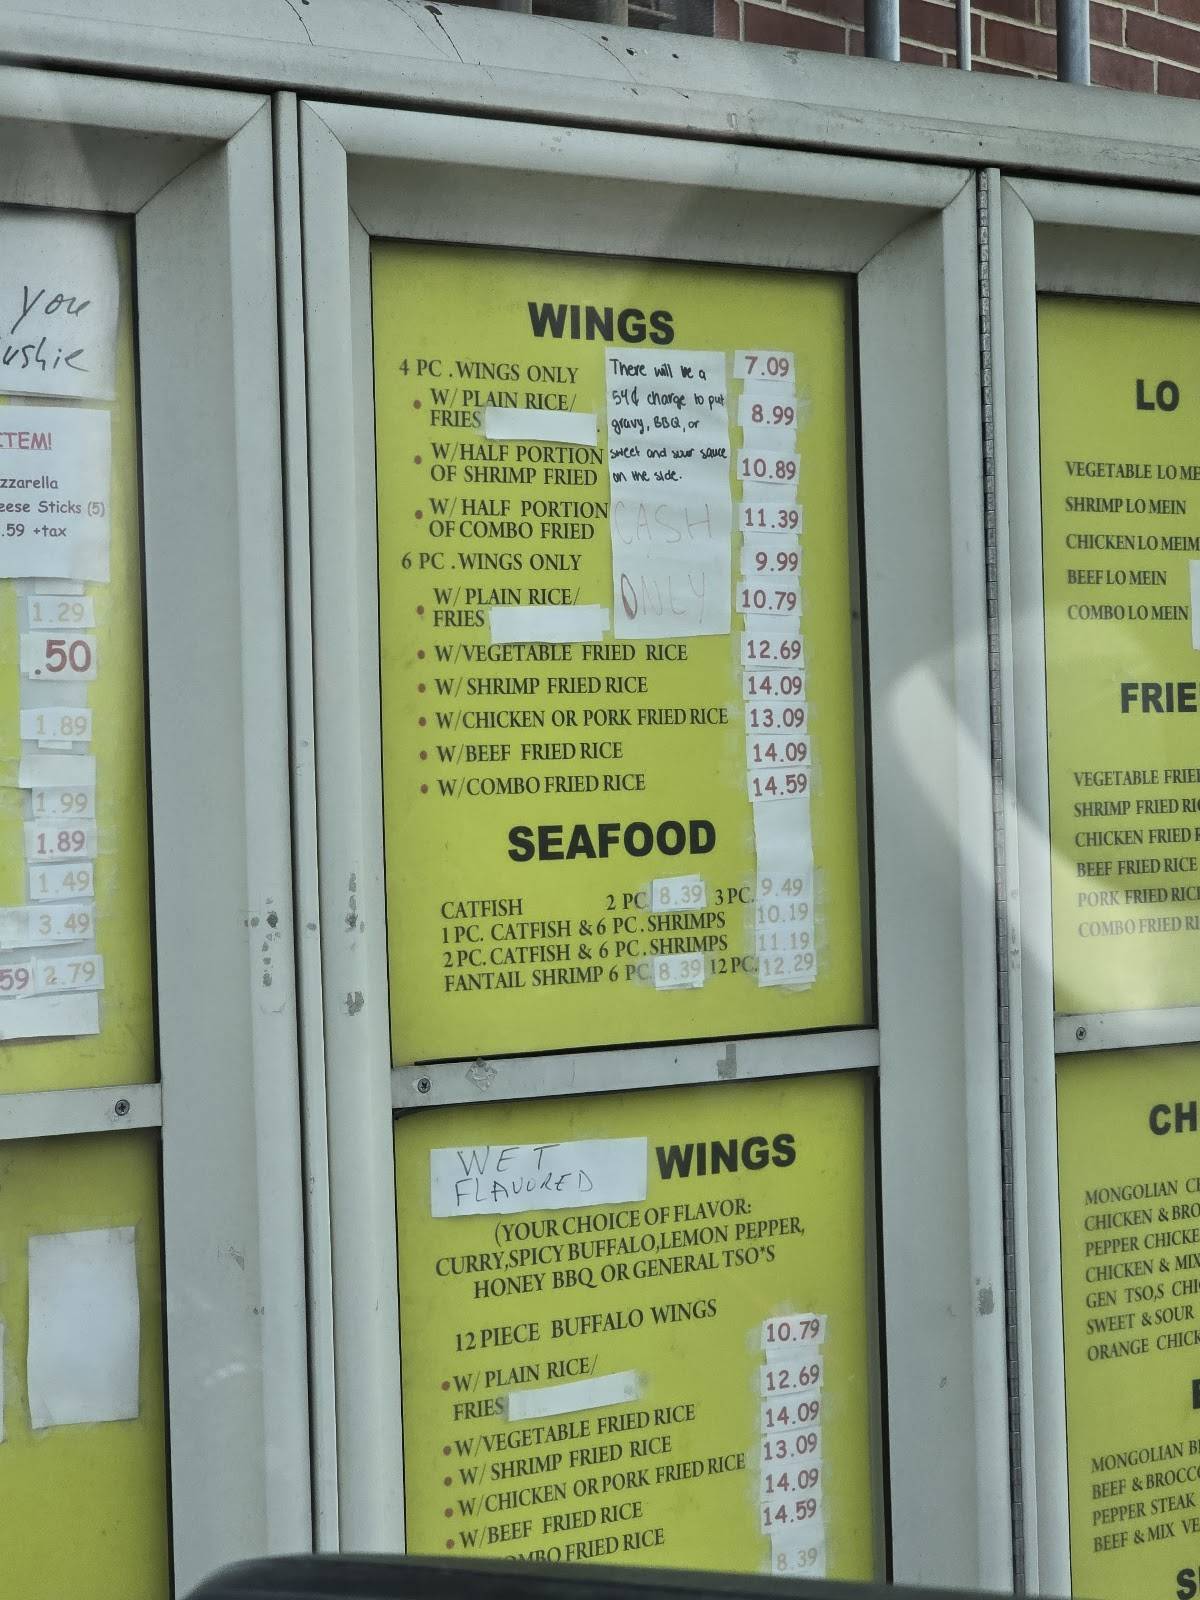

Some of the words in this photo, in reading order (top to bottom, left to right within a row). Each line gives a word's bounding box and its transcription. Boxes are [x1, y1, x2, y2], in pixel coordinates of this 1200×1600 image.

[528, 301, 674, 345] WINGS
[527, 365, 578, 383] ONLY
[609, 359, 646, 377] There
[653, 365, 673, 379] will
[698, 369, 706, 380] a
[745, 356, 789, 376] 7.09
[523, 393, 576, 412] RICE/
[647, 391, 687, 410] charge
[694, 392, 704, 404] to
[708, 395, 725, 408] put
[1136, 378, 1179, 411] LO
[430, 410, 481, 428] FRIES
[751, 404, 794, 425] 8.99
[612, 419, 649, 432] gravy,
[689, 419, 699, 428] or
[516, 446, 603, 464] PORTION
[610, 447, 640, 459] sweet
[647, 448, 666, 458] and
[700, 447, 727, 459] sauce
[431, 465, 458, 483] OF
[464, 466, 536, 485] SHRIMP
[544, 468, 598, 486] FRIED
[613, 471, 627, 482] on
[632, 470, 650, 481] the
[655, 469, 682, 481] side.
[742, 459, 796, 479] 10.89
[1065, 461, 1152, 480] VEGETABLE
[1157, 465, 1177, 479] LO
[38, 500, 81, 514] Sticks
[87, 501, 105, 517] (5)
[521, 501, 608, 518] PORTION
[1065, 496, 1123, 513] SHRIMP
[1127, 499, 1146, 514] LO
[1149, 499, 1186, 515] MEIN
[613, 501, 712, 544] CASH
[744, 508, 798, 530] 11.39
[33, 525, 66, 537] +tax
[430, 520, 456, 538] OF
[460, 520, 532, 539] COMBO
[540, 522, 594, 540] FRIED
[1066, 533, 1135, 550] CHICKEN
[1138, 535, 1158, 550] LO
[530, 554, 581, 571] ONLY
[755, 551, 798, 571] 9.99
[1067, 569, 1103, 585] BEEF
[1107, 570, 1126, 585] LO
[1129, 570, 1166, 585] MEIN
[528, 587, 580, 606] RICE/
[620, 573, 706, 624] ONLY
[742, 589, 796, 609] 10.79
[434, 609, 484, 627] FRIES
[1067, 604, 1125, 621] COMBO
[1128, 605, 1148, 620] LO
[1151, 605, 1189, 620] MEIN
[35, 639, 90, 675] .50
[582, 644, 635, 662] FRIED
[646, 643, 687, 661] RICE
[748, 640, 801, 659] 12.69
[547, 677, 600, 694] FRIED
[606, 676, 648, 693] RICE
[748, 676, 801, 695] 14.09
[36, 715, 87, 736] 1.89
[552, 709, 578, 727] OR
[584, 708, 632, 726] PORK
[638, 708, 686, 726] FRIED
[690, 708, 728, 725] RICE
[750, 708, 804, 728] 13.09
[521, 743, 576, 761] FRIED
[580, 741, 623, 759] RICE
[753, 743, 807, 762] 14.09
[544, 776, 599, 793] FRIED
[603, 774, 645, 792] RICE
[753, 774, 807, 796] 14.59
[1074, 770, 1159, 787] VEGETABLE
[1074, 800, 1131, 817] SHRIMP
[1136, 799, 1179, 815] FRIED
[37, 831, 85, 854] 1.89
[508, 819, 716, 862] SEAFOOD
[1075, 830, 1143, 847] CHICKEN
[1149, 828, 1191, 844] FRIED
[1076, 862, 1112, 877] BEEF
[1118, 859, 1160, 875] FRIED
[1164, 857, 1197, 873] RICE
[660, 884, 702, 904] 8.39
[1078, 892, 1120, 907] PORK
[1125, 888, 1167, 904] FRIED
[441, 898, 522, 920] CATFISH
[39, 913, 90, 935] 3.49
[491, 918, 571, 941] CATFISH
[1078, 920, 1135, 938] COMBO
[1139, 917, 1181, 933] FRIED
[492, 944, 571, 964] CATFISH
[660, 958, 701, 978] 8.39
[445, 970, 525, 992] FANTAIL
[531, 966, 602, 988] SHRIMP
[457, 1144, 560, 1176] WET
[656, 1133, 796, 1179] WINGS
[1085, 1180, 1178, 1206] MONGOLIAN
[563, 1210, 640, 1236] CHOICE
[644, 1208, 669, 1225] OF
[674, 1198, 752, 1223] FLAVOR:
[1085, 1209, 1152, 1231] CHICKEN
[736, 1216, 804, 1242] PEPPER,
[1086, 1237, 1139, 1257] PEPPER
[474, 1273, 555, 1299] HONEY
[552, 1268, 596, 1290] BBQ
[601, 1263, 628, 1282] OR
[633, 1253, 719, 1278] GENERAL
[1086, 1260, 1153, 1282] CHICKEN
[1087, 1290, 1117, 1309] GEN
[480, 1322, 540, 1349] PIECE
[551, 1308, 643, 1339] BUFFALO
[651, 1298, 717, 1326] WINGS
[1087, 1313, 1135, 1335] SWEET
[1155, 1305, 1193, 1324] SOUR
[766, 1319, 820, 1343] 10.79
[1088, 1339, 1148, 1361] ORANGE
[766, 1365, 820, 1390] 12.69
[454, 1398, 504, 1420] FRIES
[598, 1411, 649, 1434] FRIED
[653, 1404, 696, 1425] RICE
[765, 1401, 818, 1427] 14.09
[569, 1443, 622, 1468] FRIED
[629, 1435, 672, 1457] RICE
[764, 1433, 817, 1460] 13.09
[1092, 1442, 1183, 1473] MONGOLIAN
[573, 1476, 598, 1495] OR
[601, 1470, 650, 1492] PORK
[655, 1459, 704, 1483] FRIED
[707, 1453, 745, 1474] RICE
[765, 1468, 818, 1493] 14.09
[1092, 1479, 1126, 1500] BEEF
[543, 1509, 596, 1532] FRIED
[600, 1501, 643, 1524] RICE
[764, 1499, 816, 1526] 14.59
[1093, 1503, 1145, 1526] PEPPER
[1151, 1493, 1195, 1515] STEAK
[566, 1538, 618, 1560] FRIED
[623, 1528, 665, 1552] RICE
[1094, 1532, 1128, 1553] BEEF
[1148, 1523, 1175, 1541] MIX
